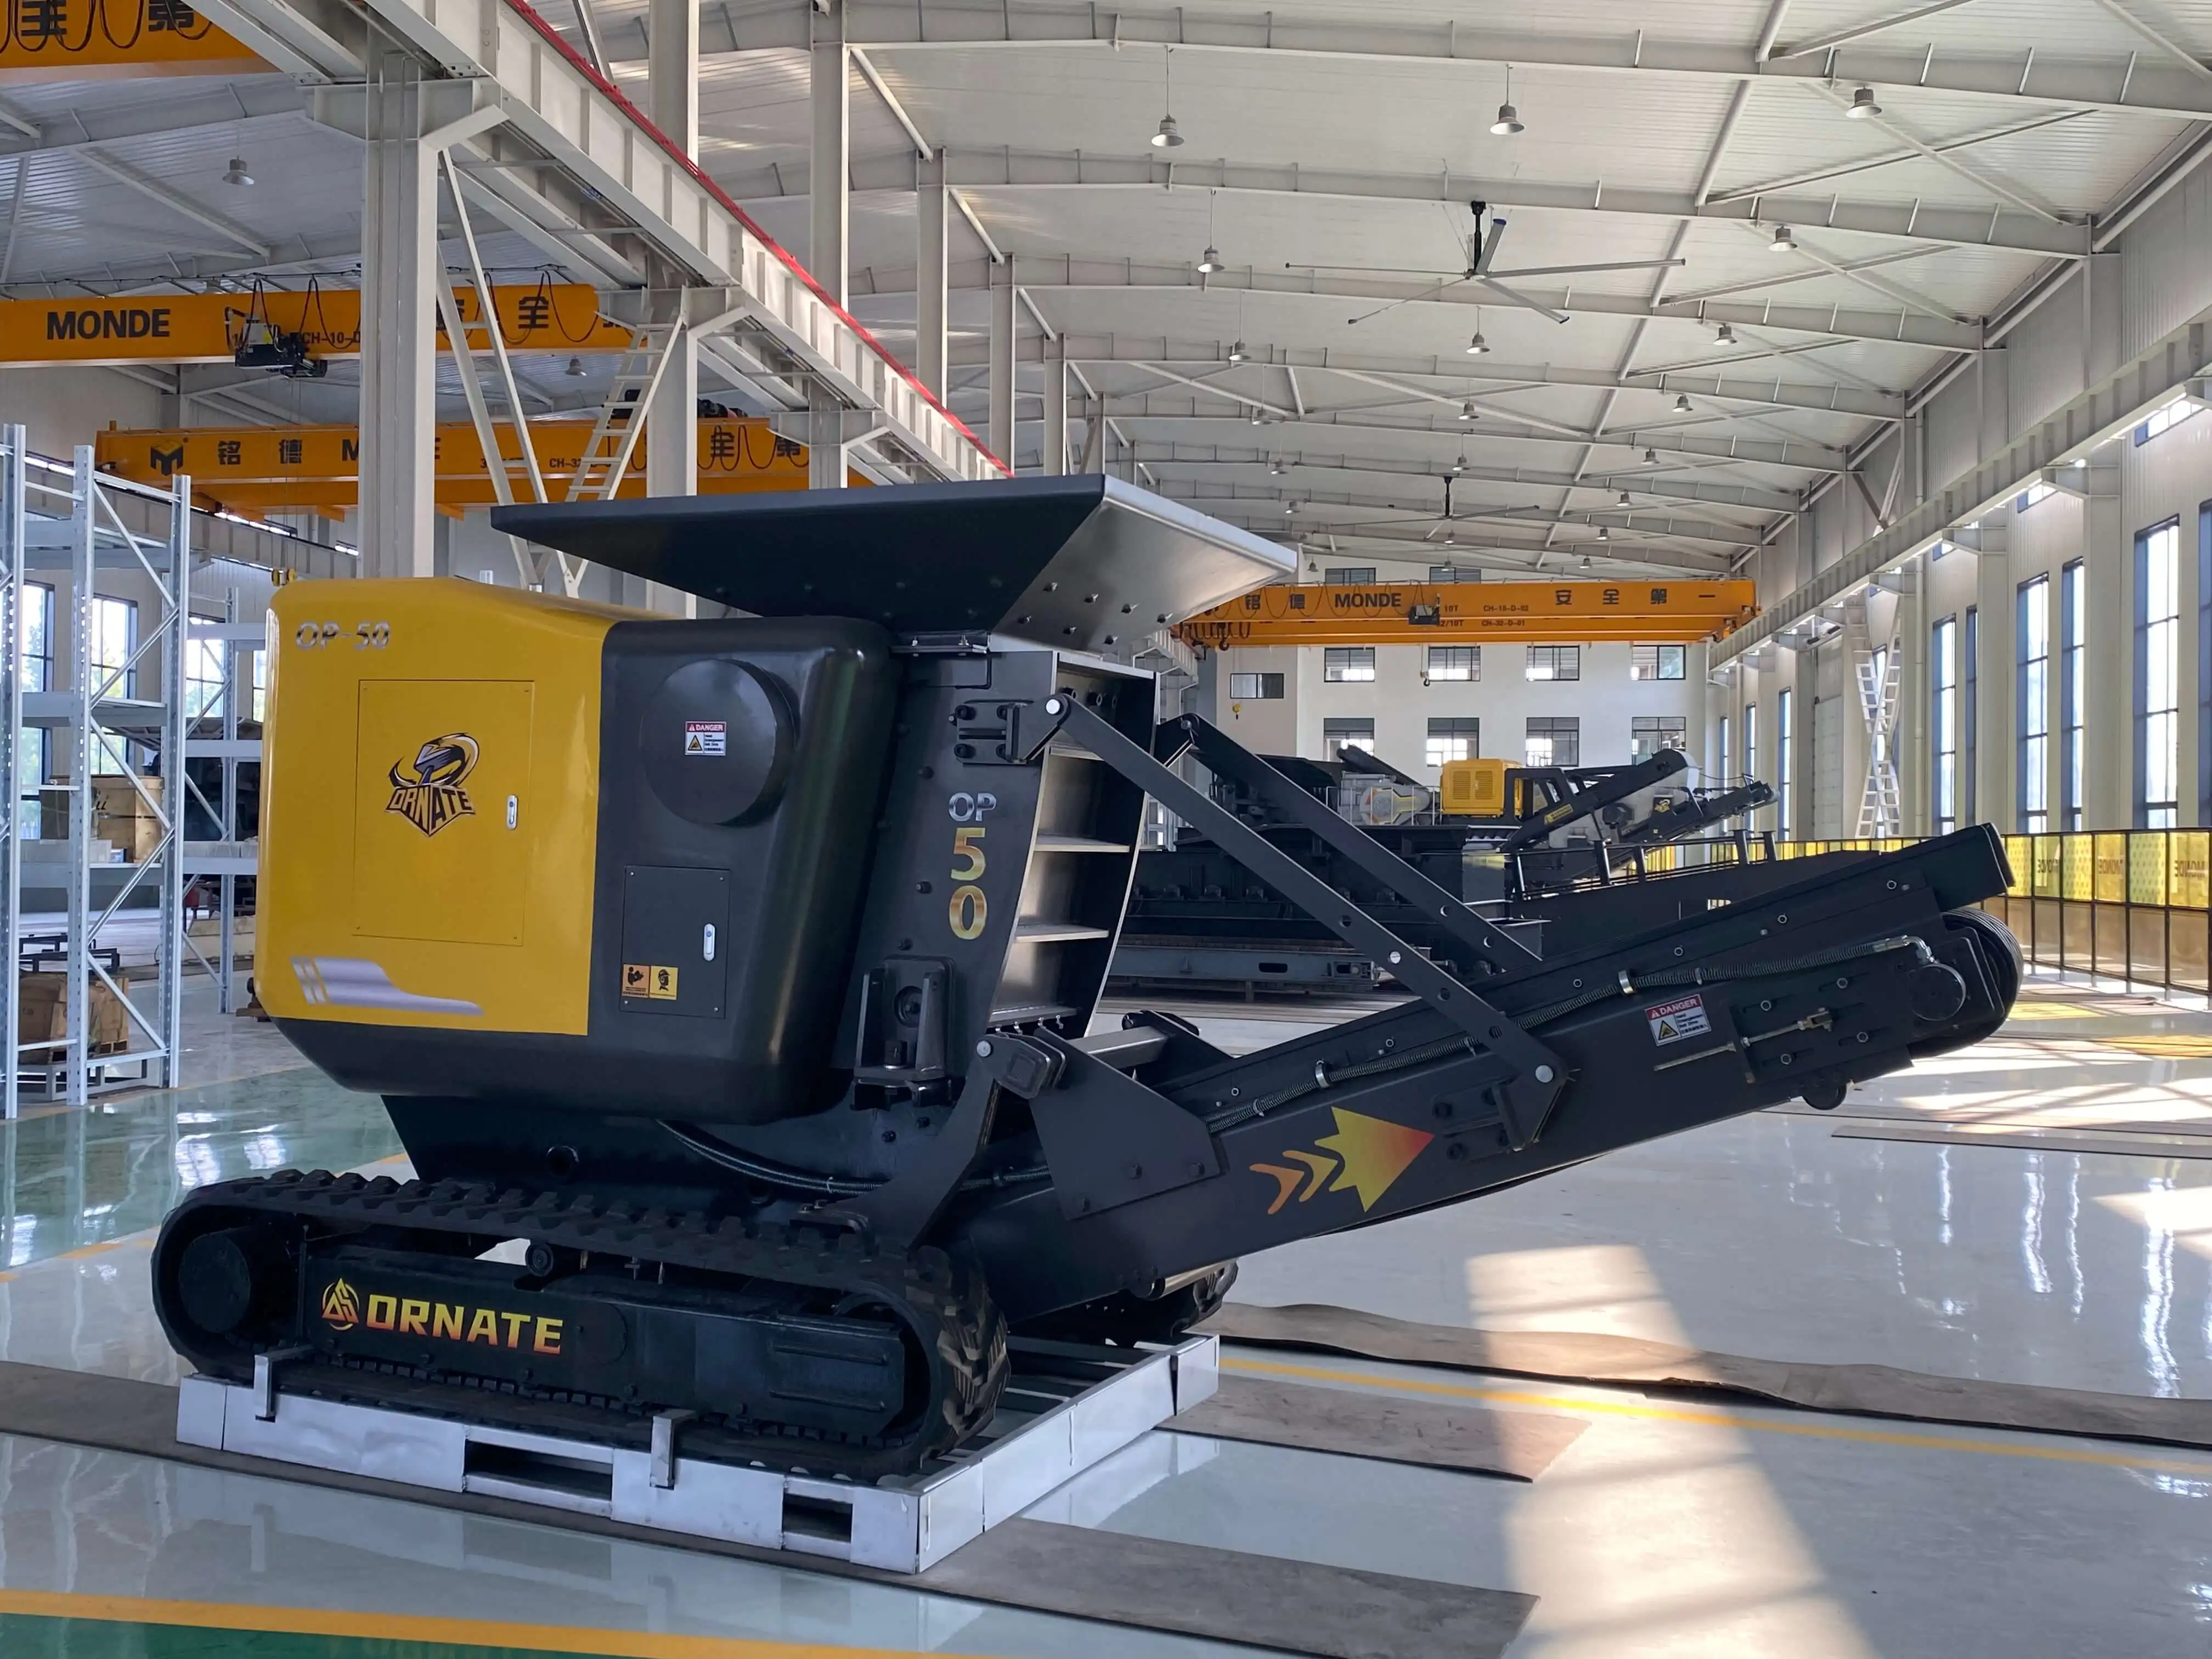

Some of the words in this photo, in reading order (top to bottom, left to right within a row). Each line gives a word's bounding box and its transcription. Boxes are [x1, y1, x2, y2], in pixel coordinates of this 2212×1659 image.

[47, 309, 170, 340] MONDE
[1335, 592, 1401, 608] MONDE
[296, 621, 390, 650] OP-50
[389, 787, 473, 832] ORNATE
[949, 792, 996, 821] OP
[1660, 999, 1697, 1015] DANGER
[366, 1294, 563, 1355] ORNATE
